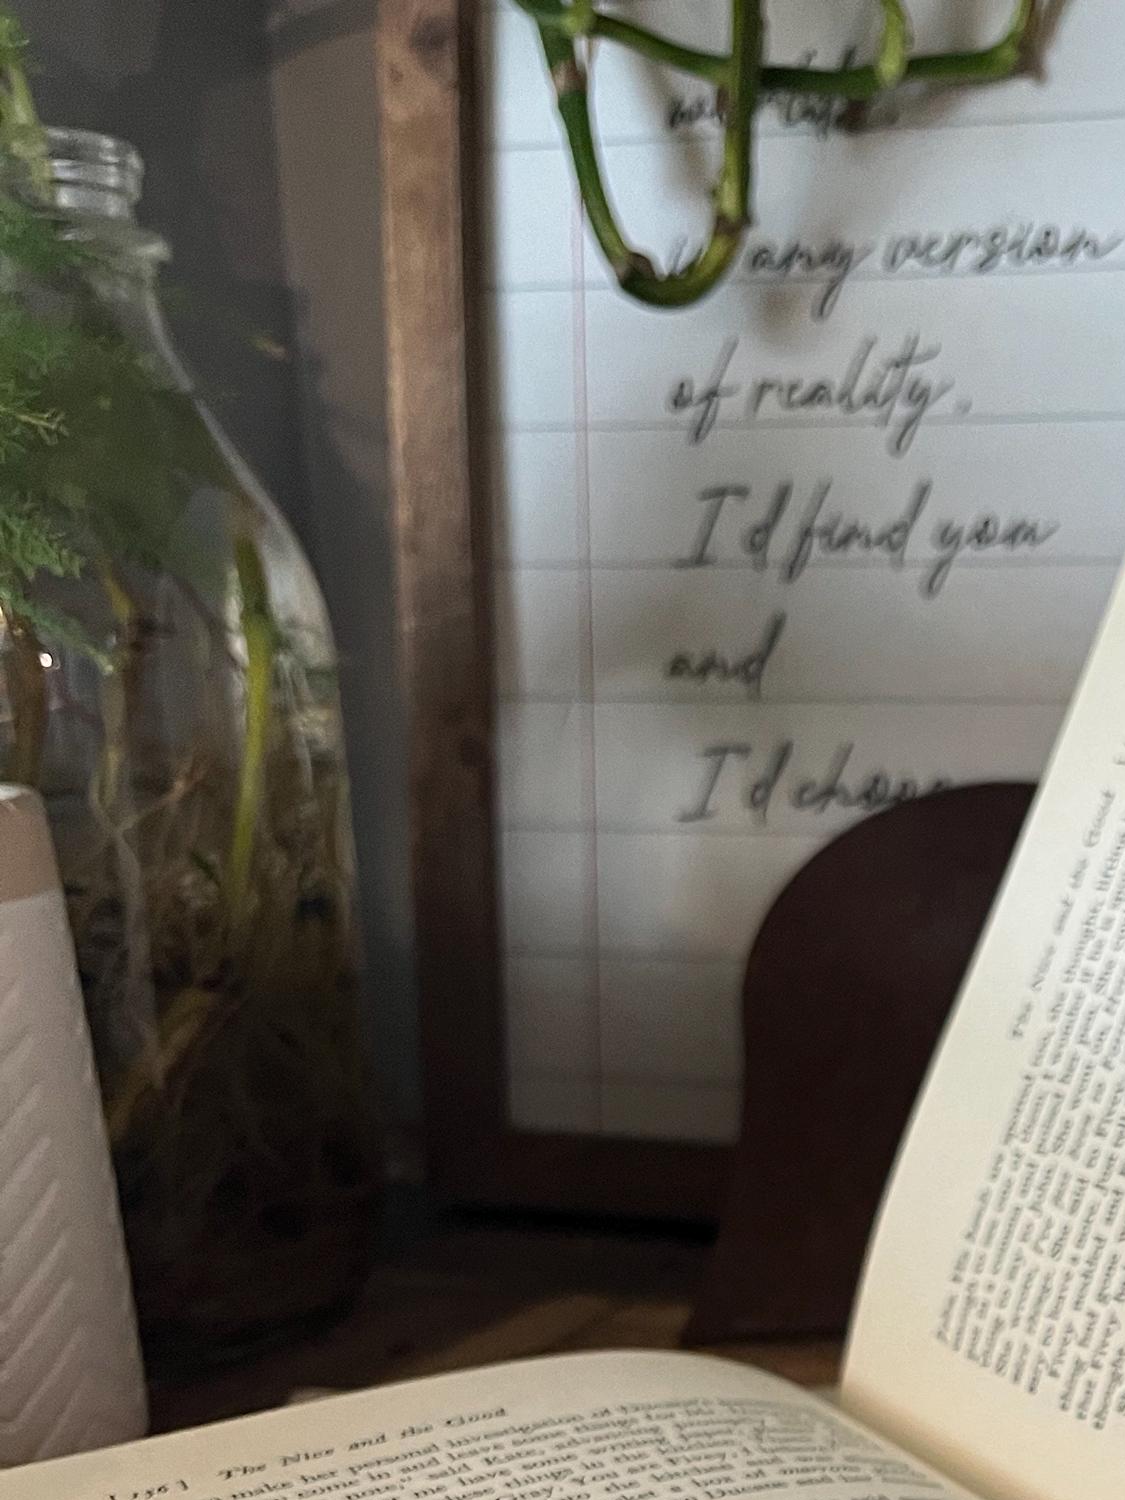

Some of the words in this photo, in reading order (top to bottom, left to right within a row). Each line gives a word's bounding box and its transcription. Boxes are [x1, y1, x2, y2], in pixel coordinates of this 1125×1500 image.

[748, 237, 873, 321] any
[885, 222, 1125, 275] version
[667, 336, 739, 446] of
[778, 476, 932, 584] find
[925, 515, 1061, 600] you
[665, 608, 787, 700] and
